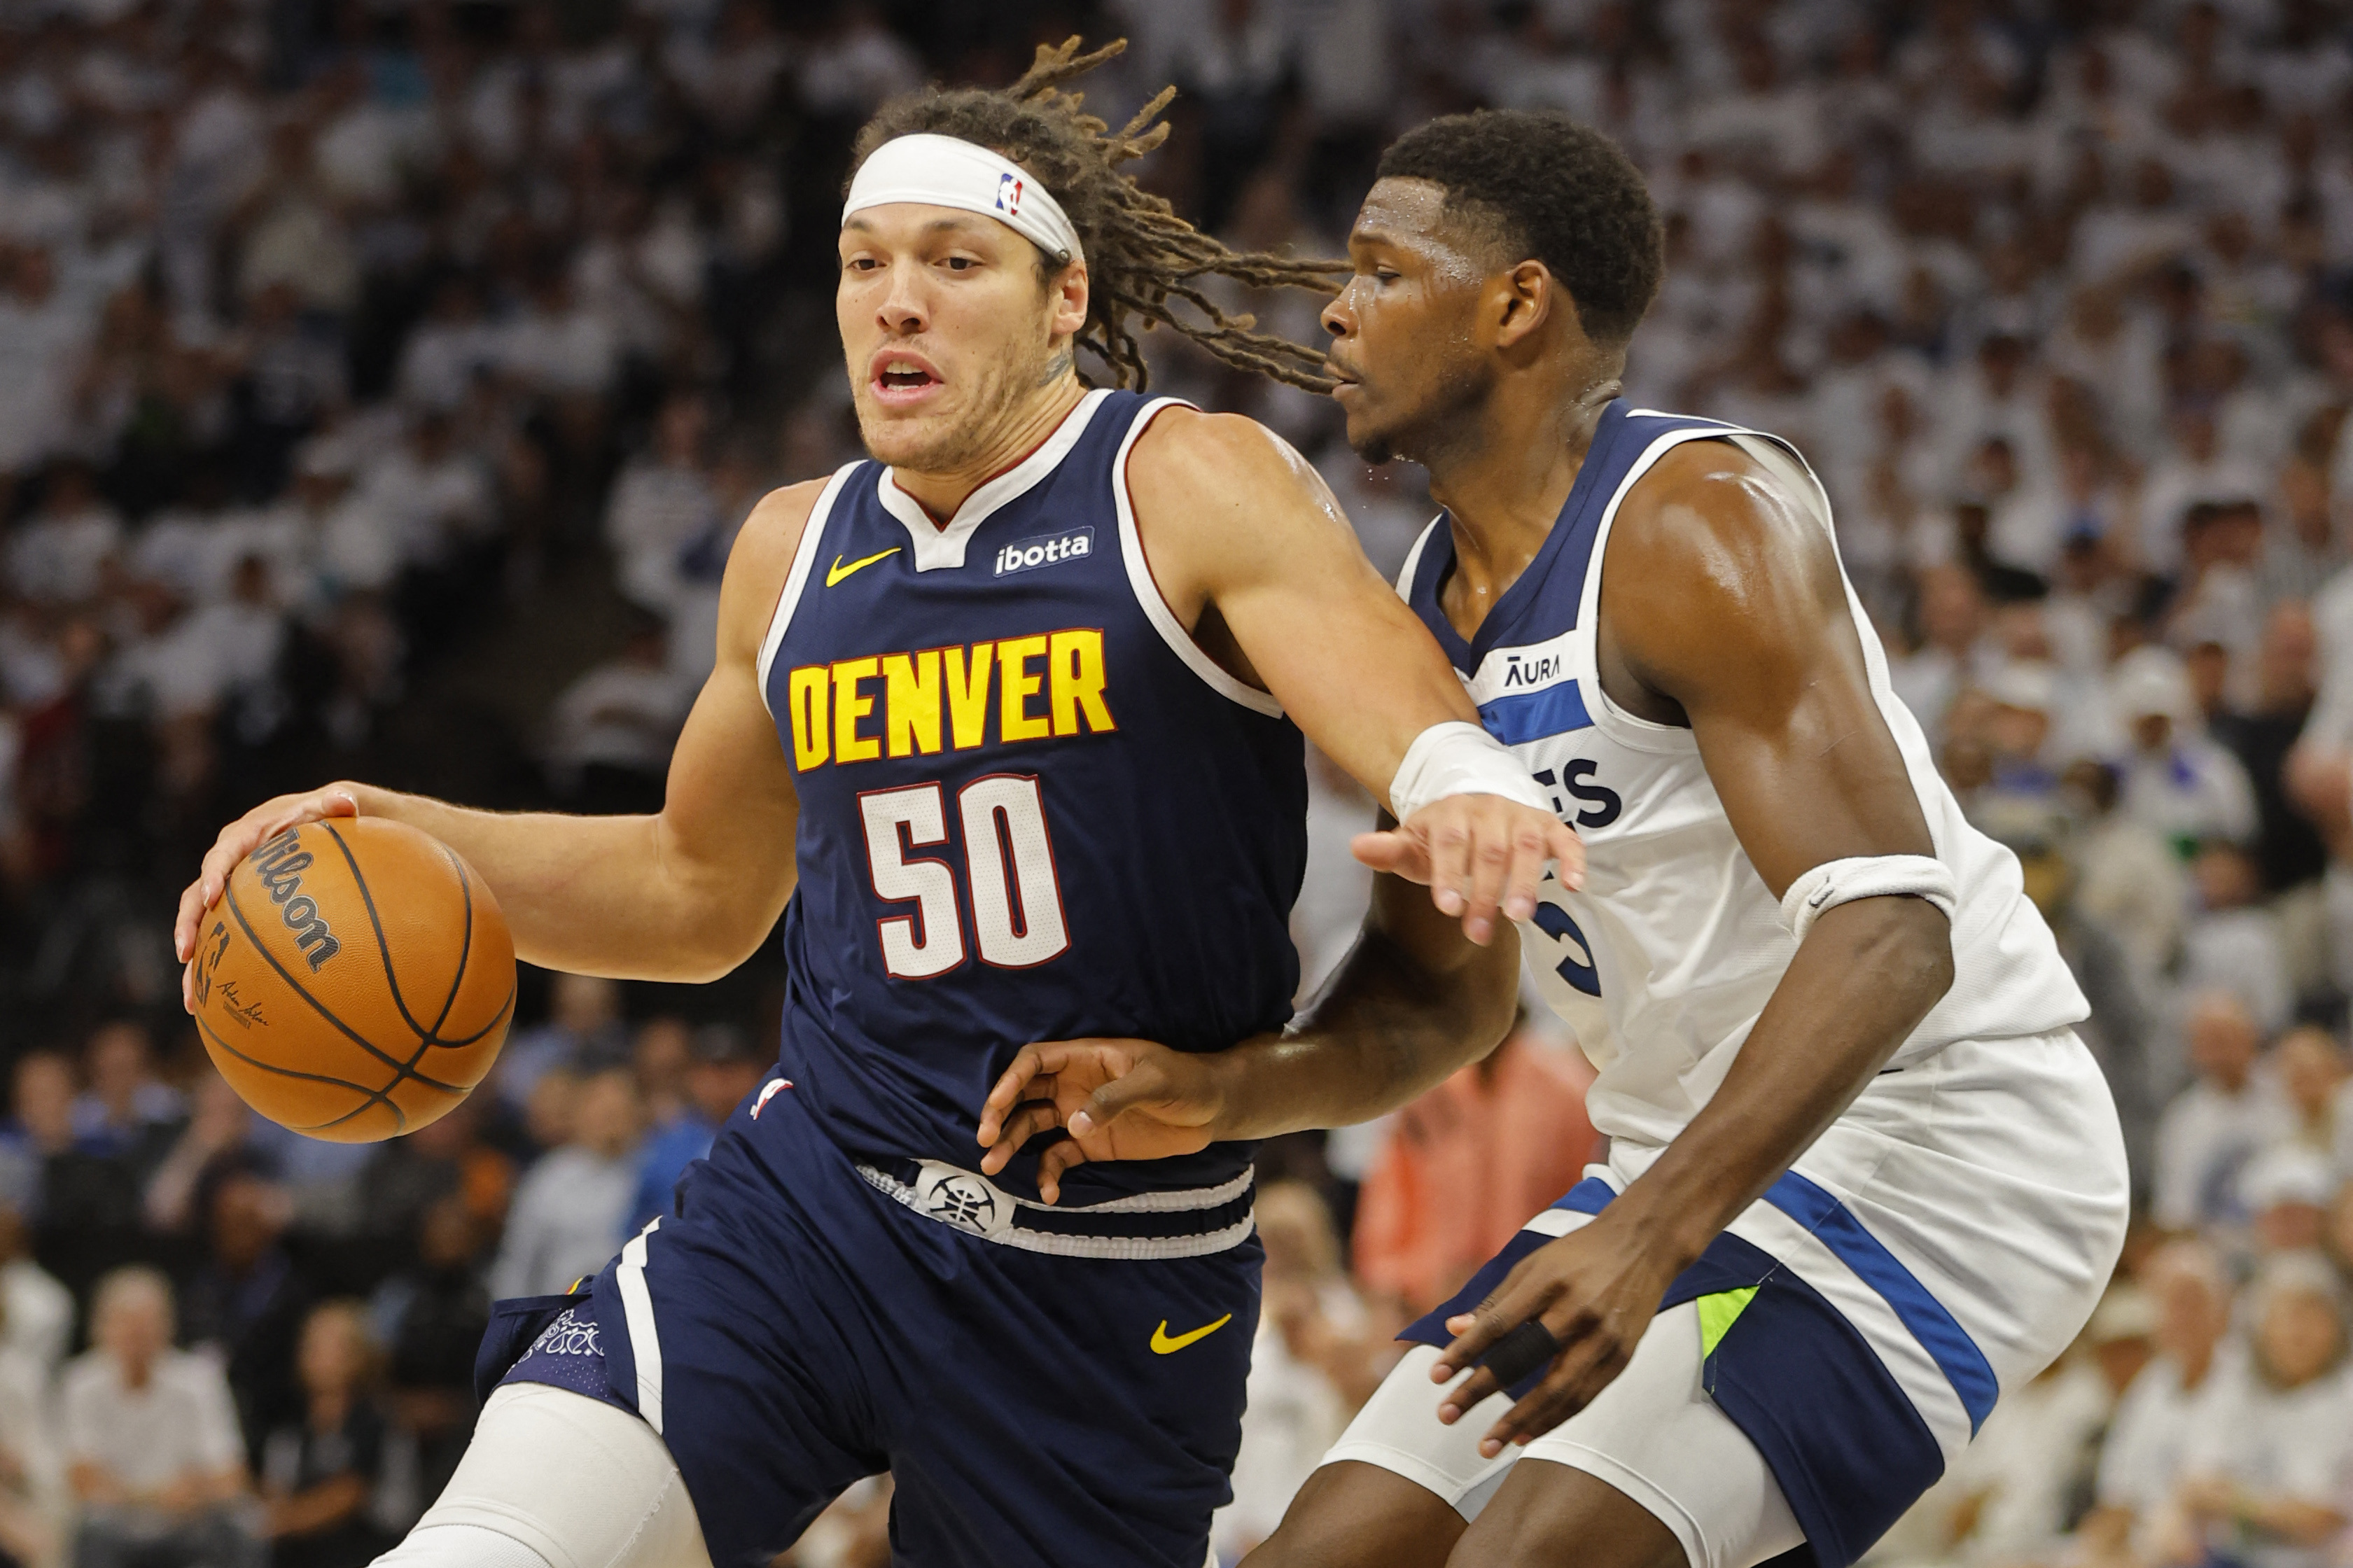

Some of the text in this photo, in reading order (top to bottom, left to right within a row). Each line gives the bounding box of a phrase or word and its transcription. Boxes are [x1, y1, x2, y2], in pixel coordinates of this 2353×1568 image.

[996, 536, 1089, 575] ibotta
[789, 628, 1119, 774] DENVER
[856, 772, 1072, 980] 50
